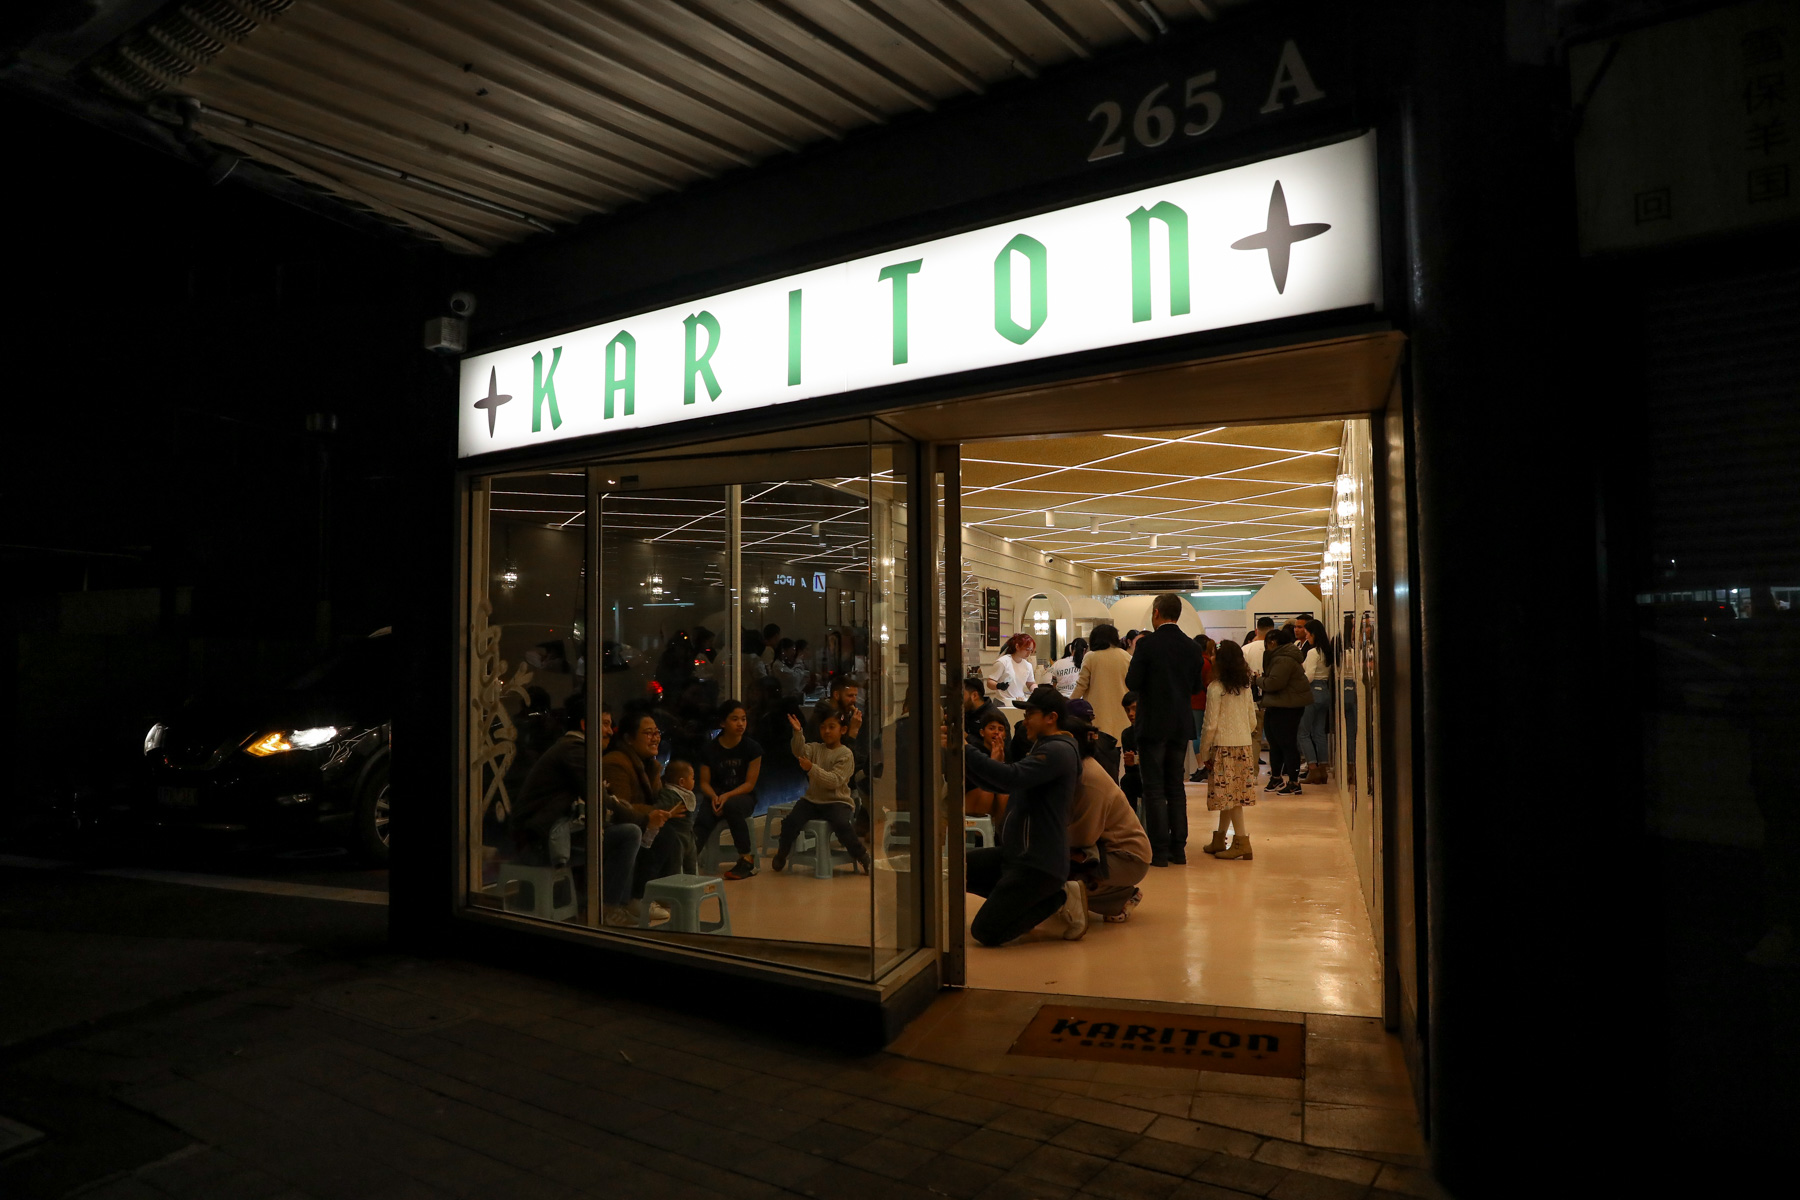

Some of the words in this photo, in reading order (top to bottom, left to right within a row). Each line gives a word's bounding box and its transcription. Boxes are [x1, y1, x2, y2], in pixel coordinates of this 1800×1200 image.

[1087, 69, 1223, 163] 265
[1259, 37, 1327, 114] A
[533, 202, 1190, 432] KARITON
[1050, 1018, 1279, 1052] KARITON
